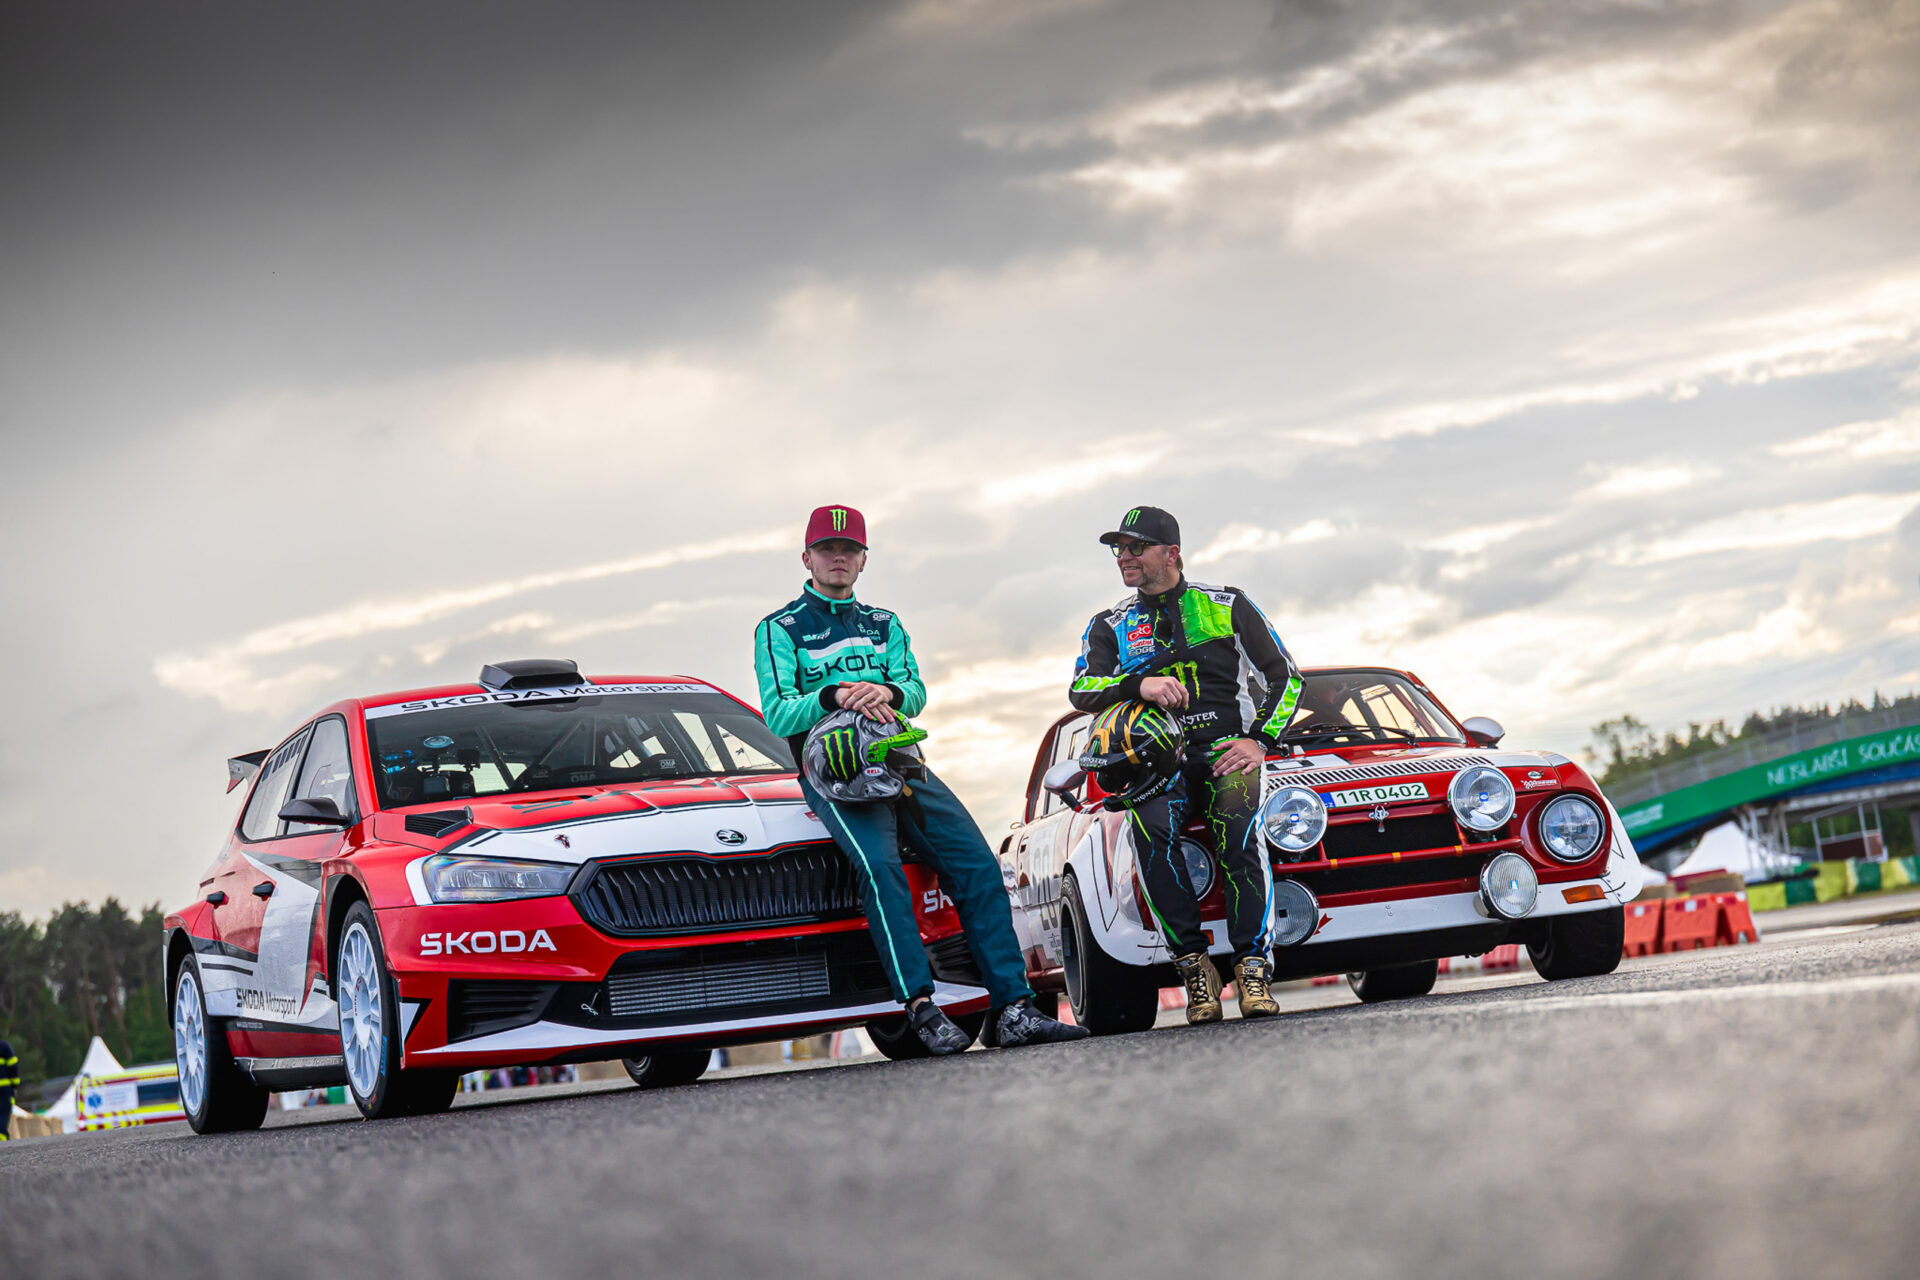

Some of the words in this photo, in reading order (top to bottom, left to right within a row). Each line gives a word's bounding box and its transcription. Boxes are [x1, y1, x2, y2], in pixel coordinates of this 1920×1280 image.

[1129, 625, 1151, 640] CRC
[1129, 645, 1155, 656] EDGE
[401, 690, 552, 713] SKODA
[558, 683, 701, 696] Motorsport
[1132, 776, 1168, 803] MONSTER
[419, 929, 558, 956] SKODA
[235, 987, 265, 1010] SKODA
[265, 991, 297, 1019] Motorsport
